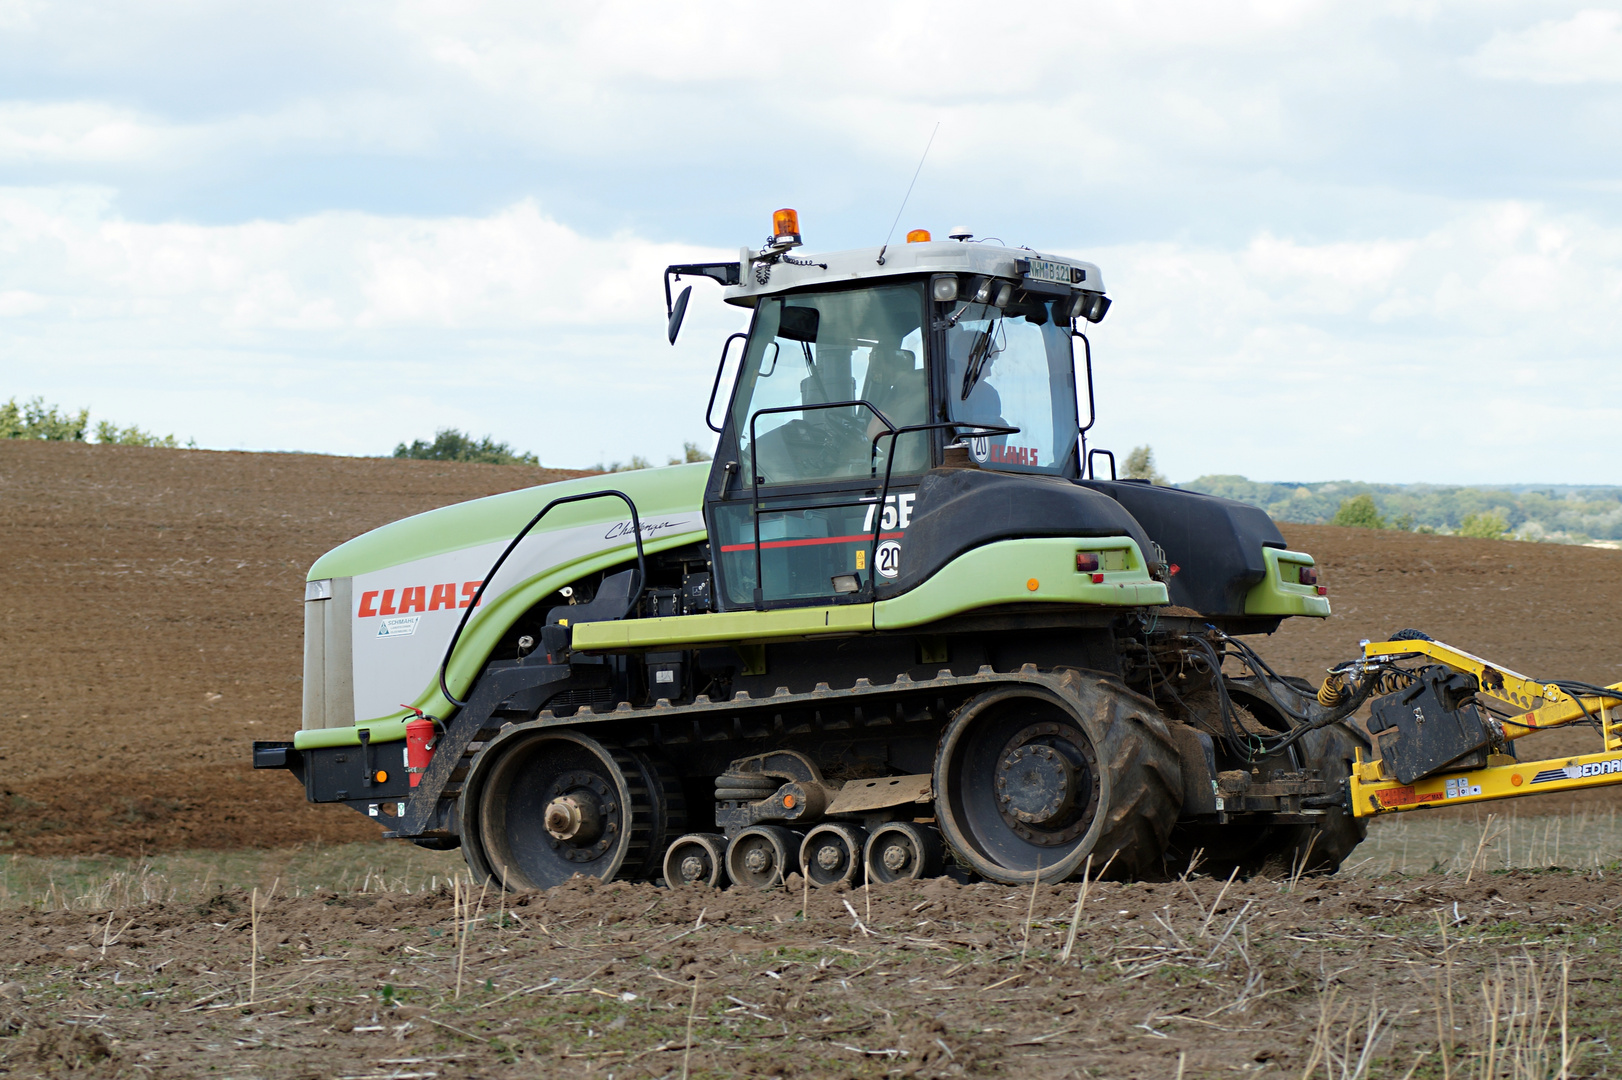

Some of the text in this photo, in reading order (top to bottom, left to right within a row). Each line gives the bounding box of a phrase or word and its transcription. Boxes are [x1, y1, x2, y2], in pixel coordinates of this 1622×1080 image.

[1050, 263, 1055, 279] B
[990, 444, 1038, 466] CLAAS
[859, 493, 916, 531] 75E
[880, 547, 900, 571] 20
[358, 580, 483, 618] CLAAS
